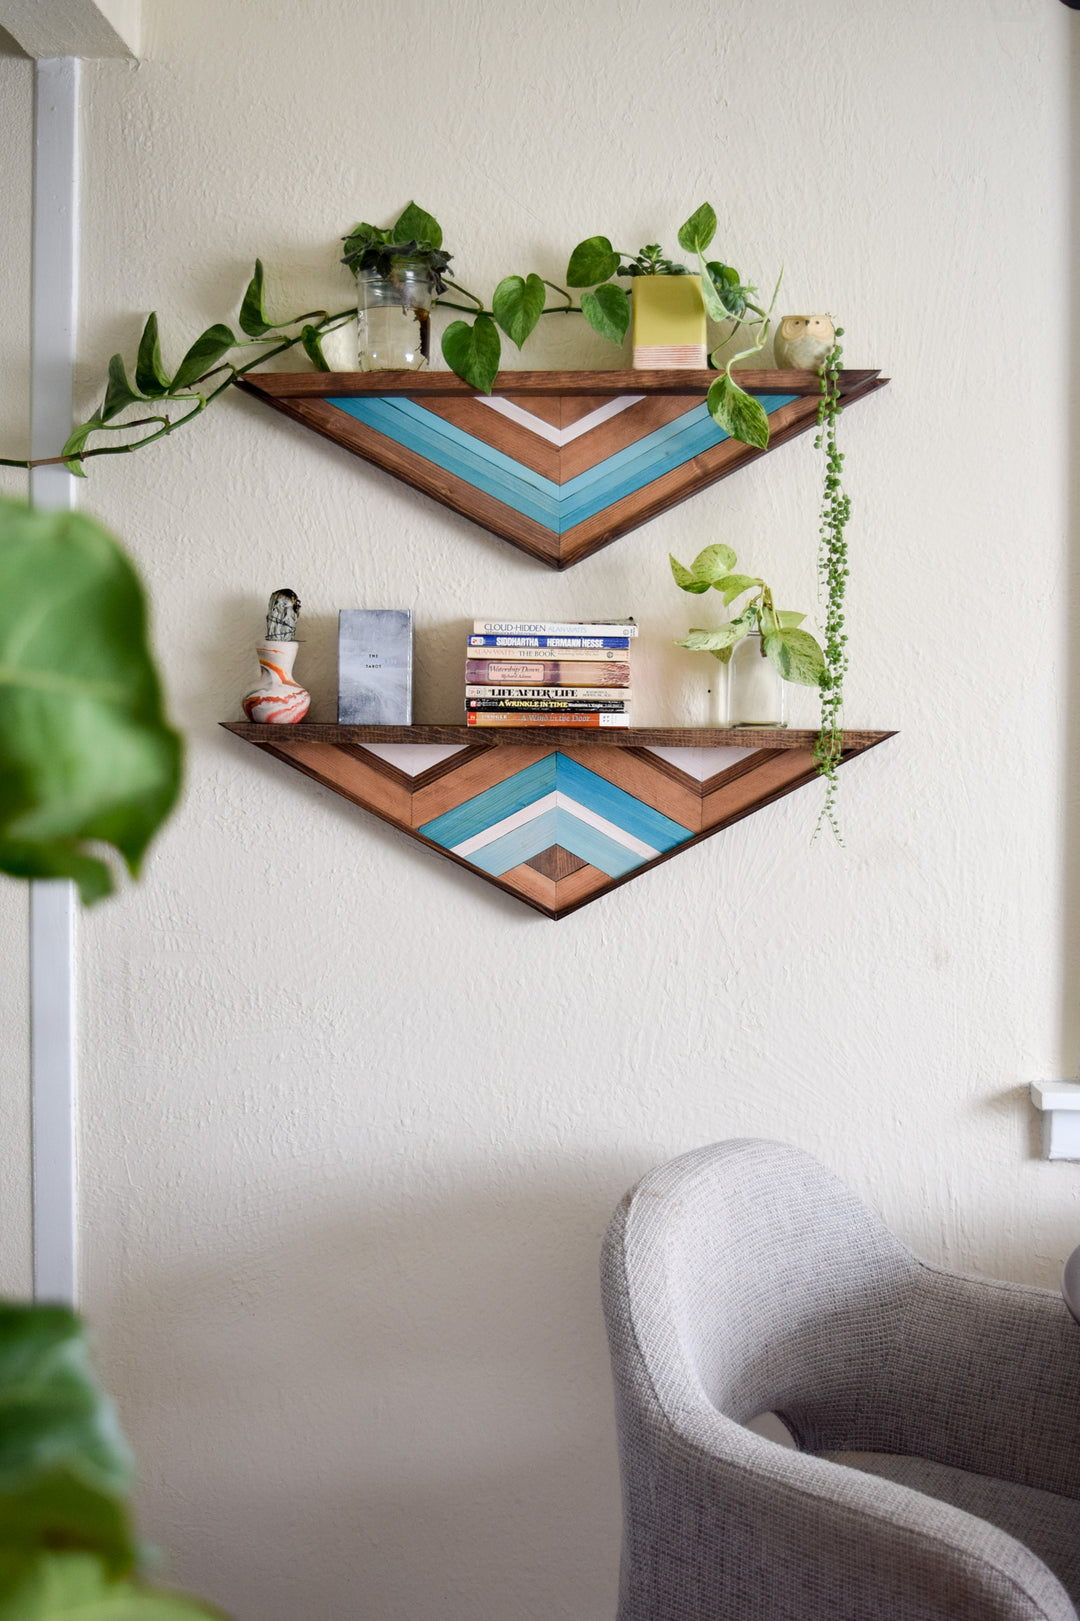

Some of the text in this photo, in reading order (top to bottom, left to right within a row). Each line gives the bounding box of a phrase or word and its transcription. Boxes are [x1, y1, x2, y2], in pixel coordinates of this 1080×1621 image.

[496, 637, 539, 647] SIDDHARTHA
[546, 638, 581, 648] HERMANN
[582, 638, 604, 648] HESSE
[490, 665, 521, 674] Watership
[516, 690, 552, 698] AFTER
